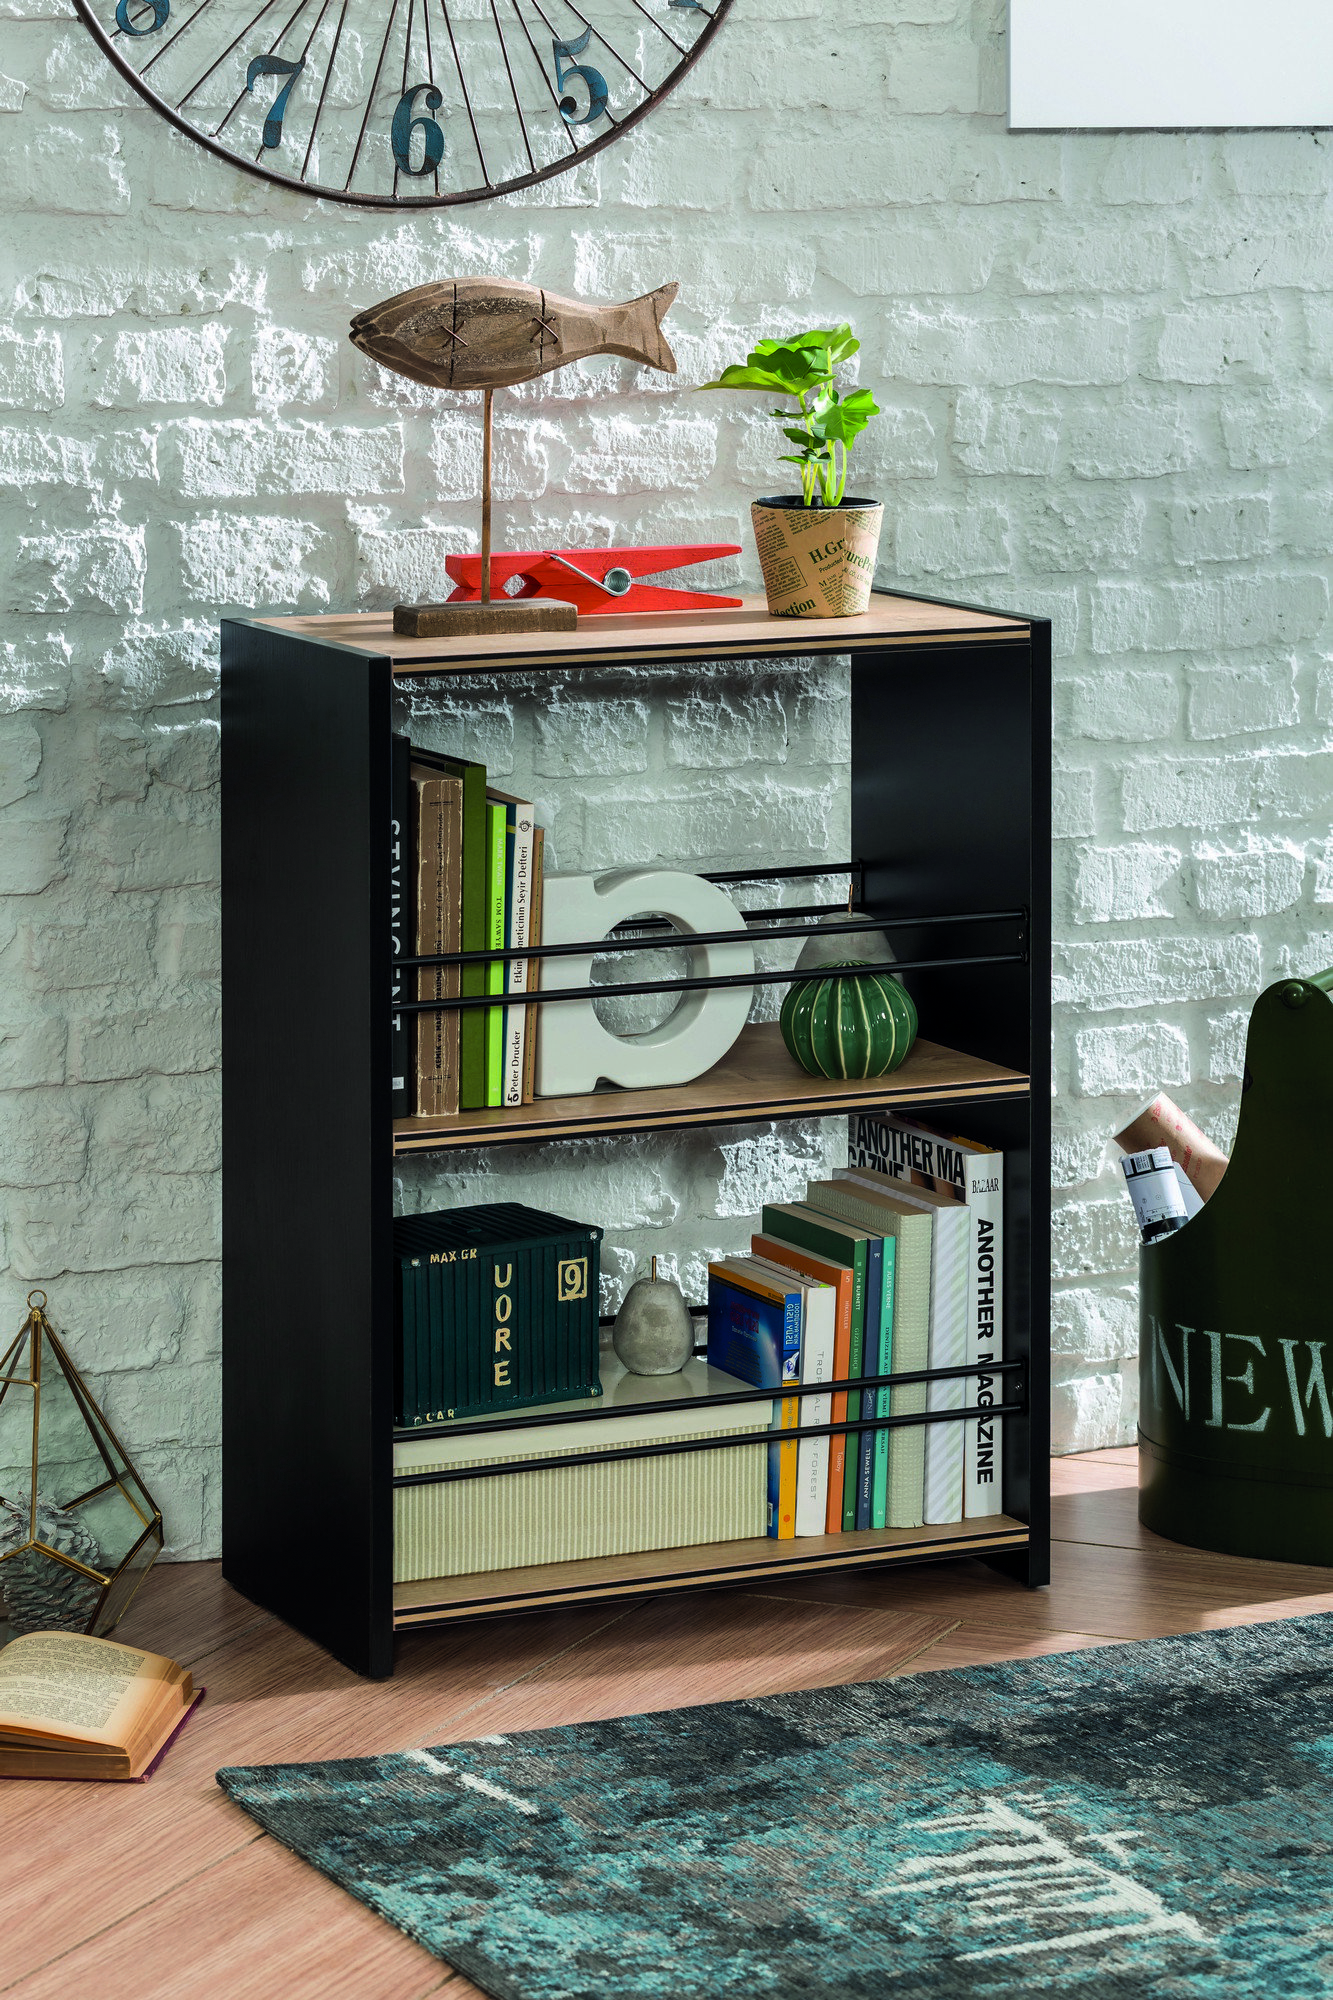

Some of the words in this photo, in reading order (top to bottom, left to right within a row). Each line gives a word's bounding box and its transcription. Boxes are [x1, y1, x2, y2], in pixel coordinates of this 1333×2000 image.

[552, 26, 609, 124] 5
[247, 54, 305, 148] 7
[391, 84, 445, 176] 6
[518, 846, 528, 878] Defteri
[517, 881, 528, 903] Seyir
[515, 906, 525, 949] neticinin
[514, 960, 523, 983] Etkin
[511, 1031, 521, 1067] Drucker
[510, 1070, 519, 1093] Peter
[857, 1116, 934, 1176] ANOTHER
[937, 1144, 966, 1187] MA
[972, 1178, 999, 1194] BAZAAR
[977, 1218, 995, 1340] ANOTHER
[814, 1351, 824, 1412] TROPAL
[810, 1452, 818, 1500] FOREST
[835, 1452, 843, 1473] Tolstoy
